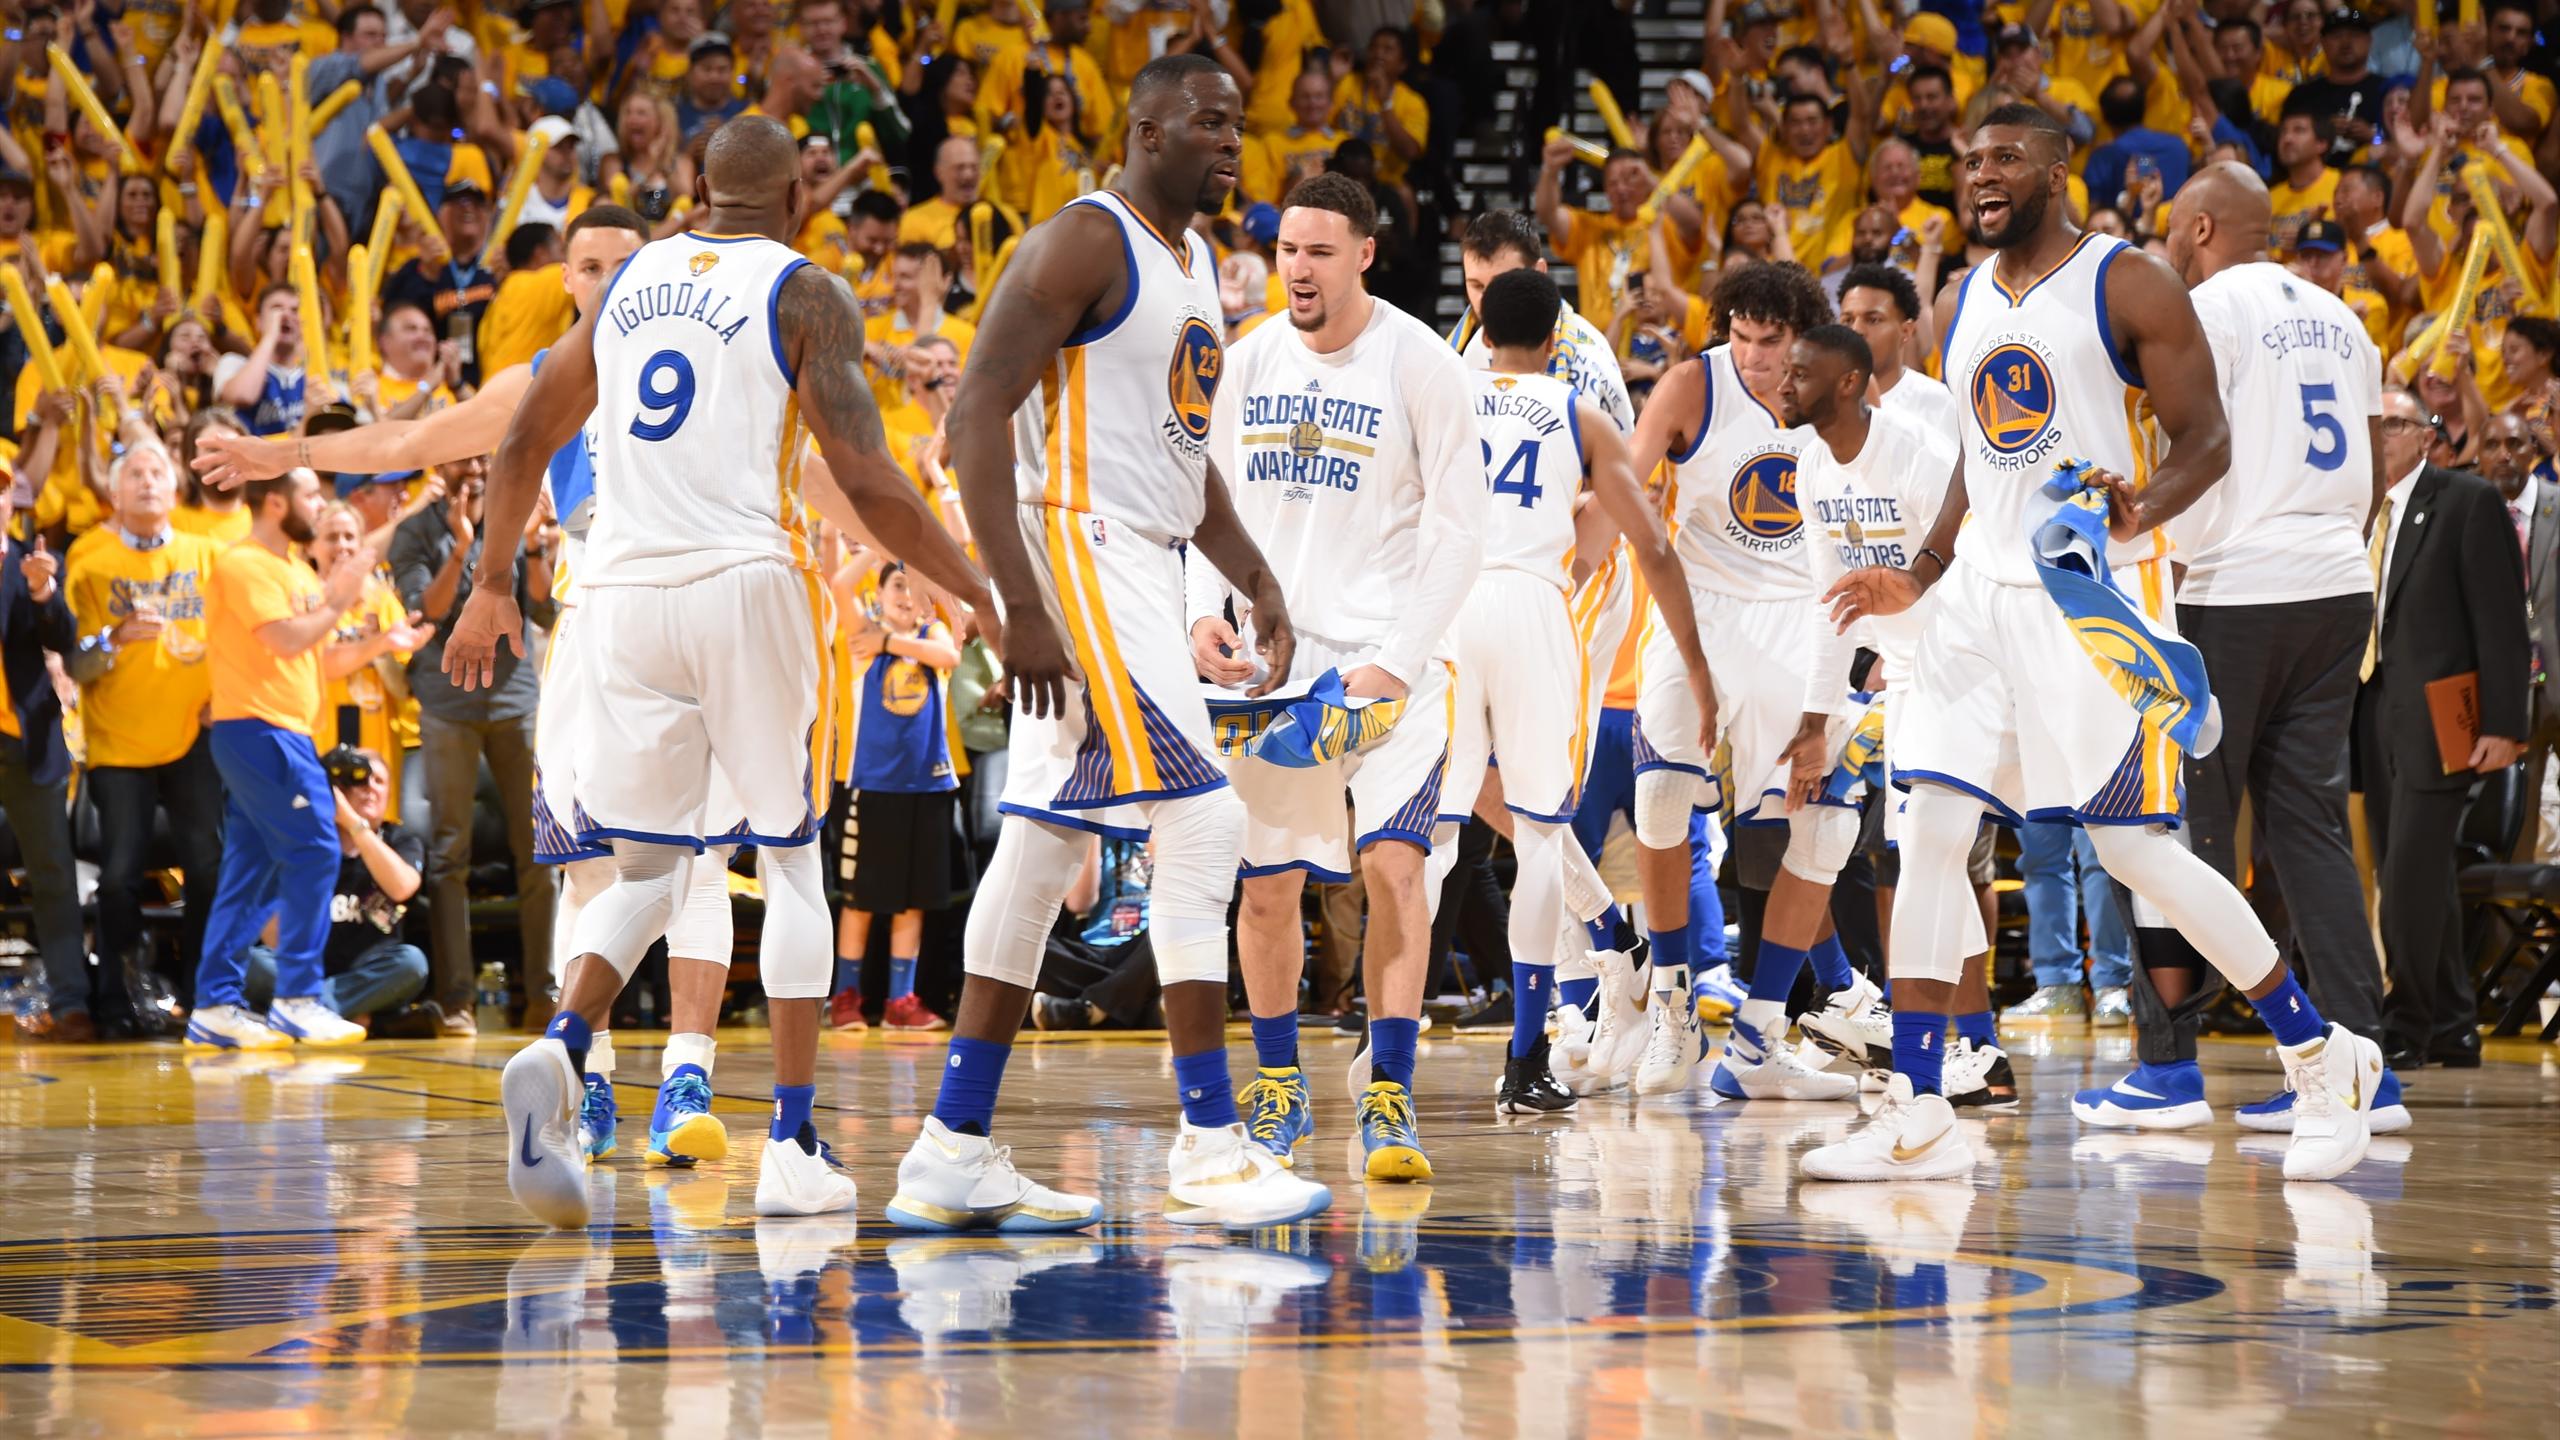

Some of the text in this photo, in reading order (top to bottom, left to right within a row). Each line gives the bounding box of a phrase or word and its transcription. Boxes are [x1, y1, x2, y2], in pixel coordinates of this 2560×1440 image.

[610, 283, 749, 345] IGUODALA
[1197, 345, 1218, 378] 23
[1968, 332, 2055, 374] GOLDEN STATE
[629, 349, 696, 442] 9
[2007, 363, 2032, 393] 31
[1243, 394, 1383, 439] GOLDEN STATE
[2299, 380, 2348, 471] 5
[1733, 443, 1785, 469] GOLDEN
[1980, 427, 2063, 473] WARRIORS
[1479, 437, 1544, 510] 4
[1778, 470, 1798, 494] 18
[1813, 497, 1902, 524] OLDEN STATE
[1725, 519, 1806, 552] WARRIOR
[330, 893, 362, 924] BA
